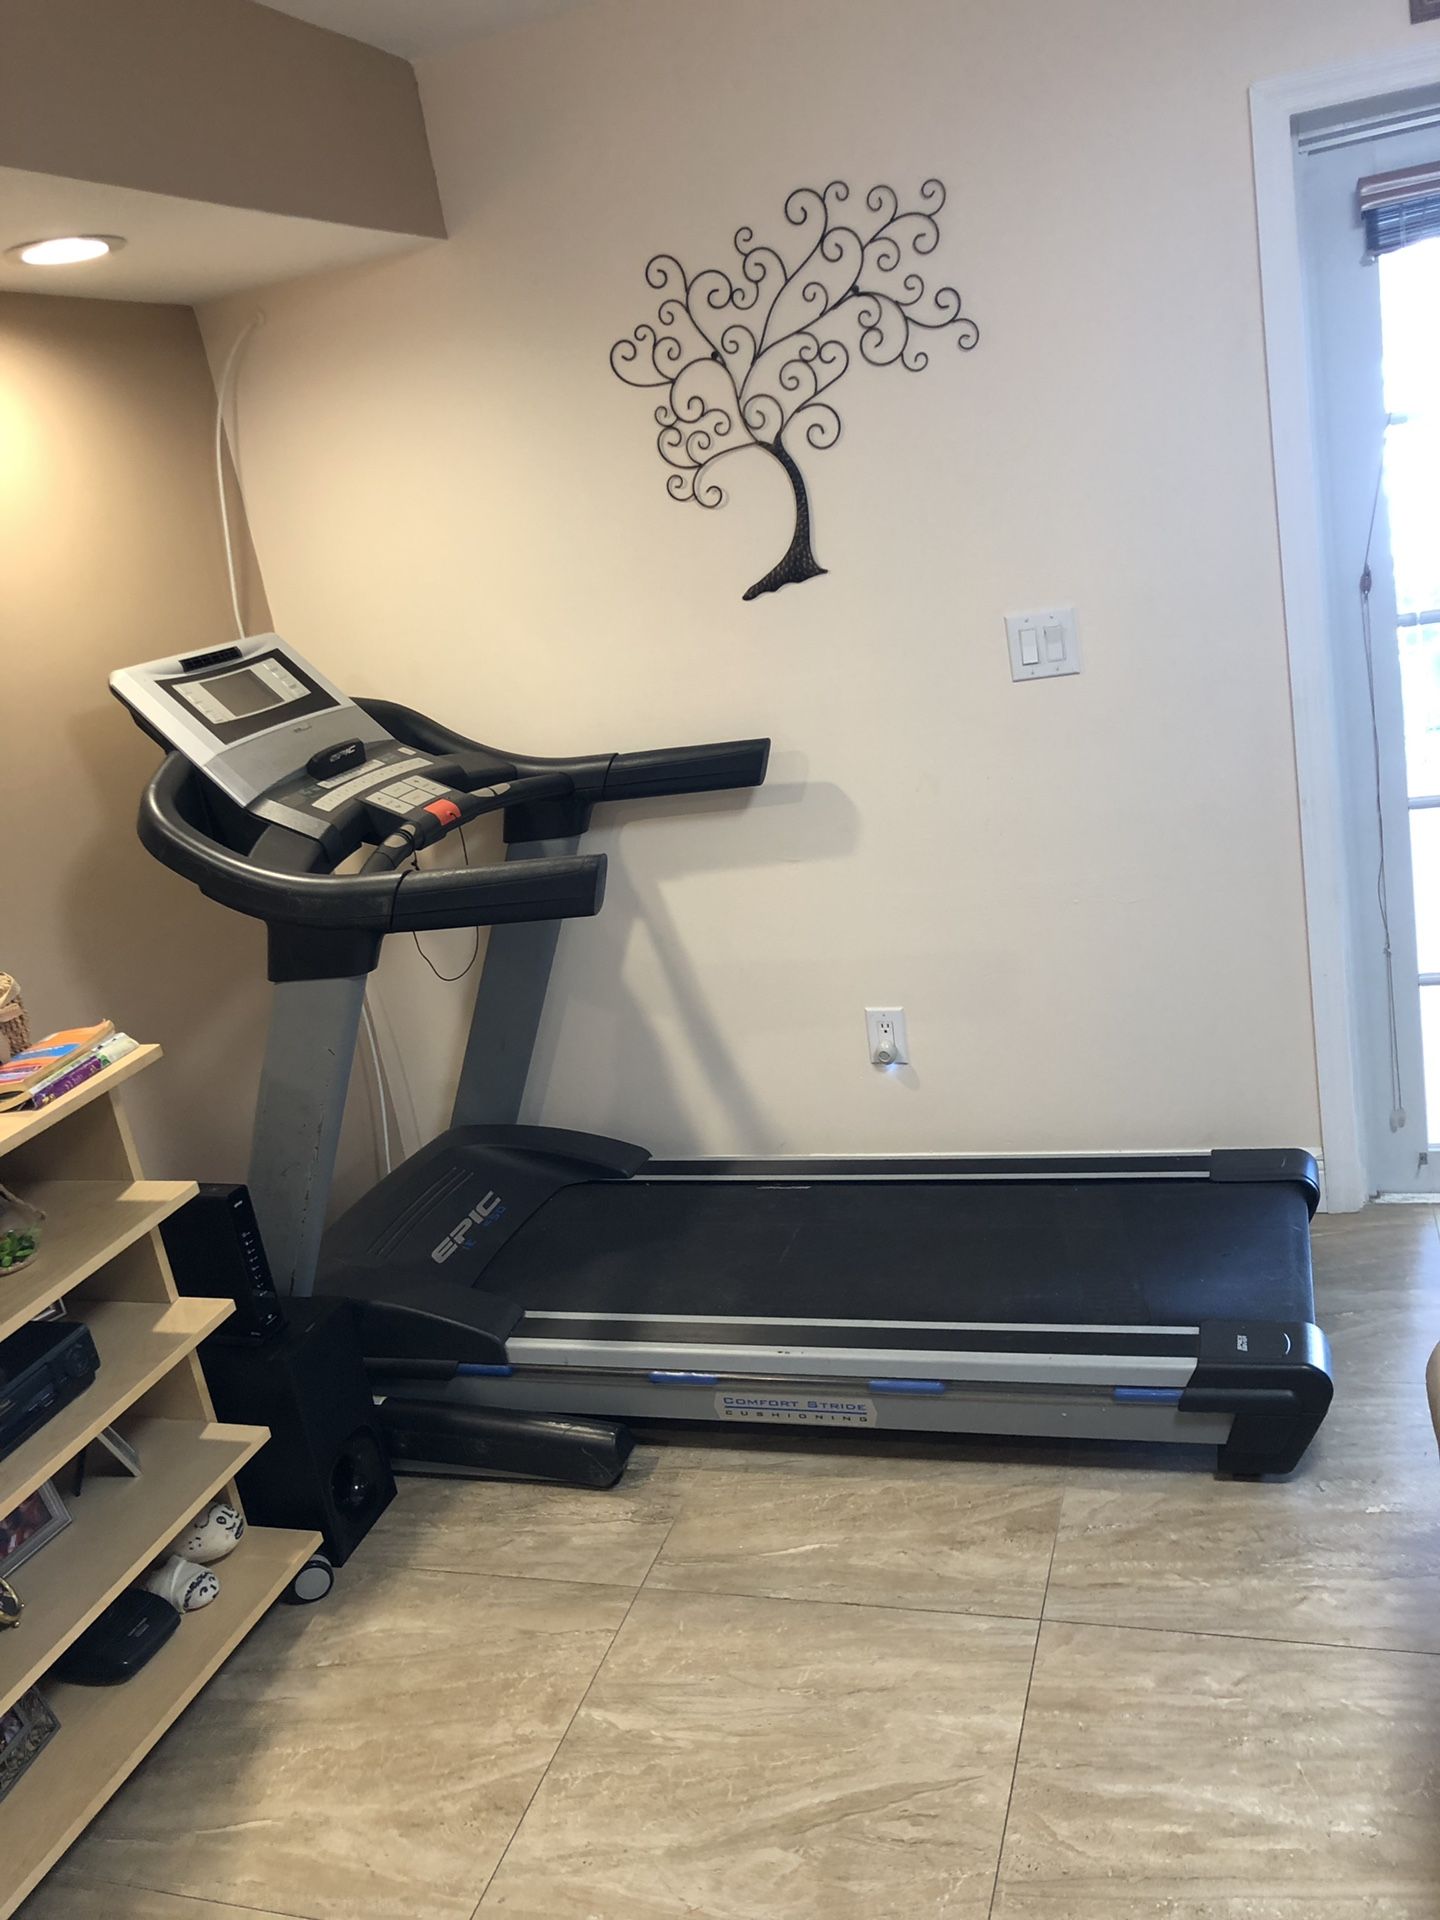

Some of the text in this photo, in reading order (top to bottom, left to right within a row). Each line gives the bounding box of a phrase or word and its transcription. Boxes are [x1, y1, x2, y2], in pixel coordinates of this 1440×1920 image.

[431, 1190, 502, 1264] EPIC
[723, 1396, 867, 1411] COMFORT STRIDE
[725, 1410, 868, 1422] CUSHIONING
